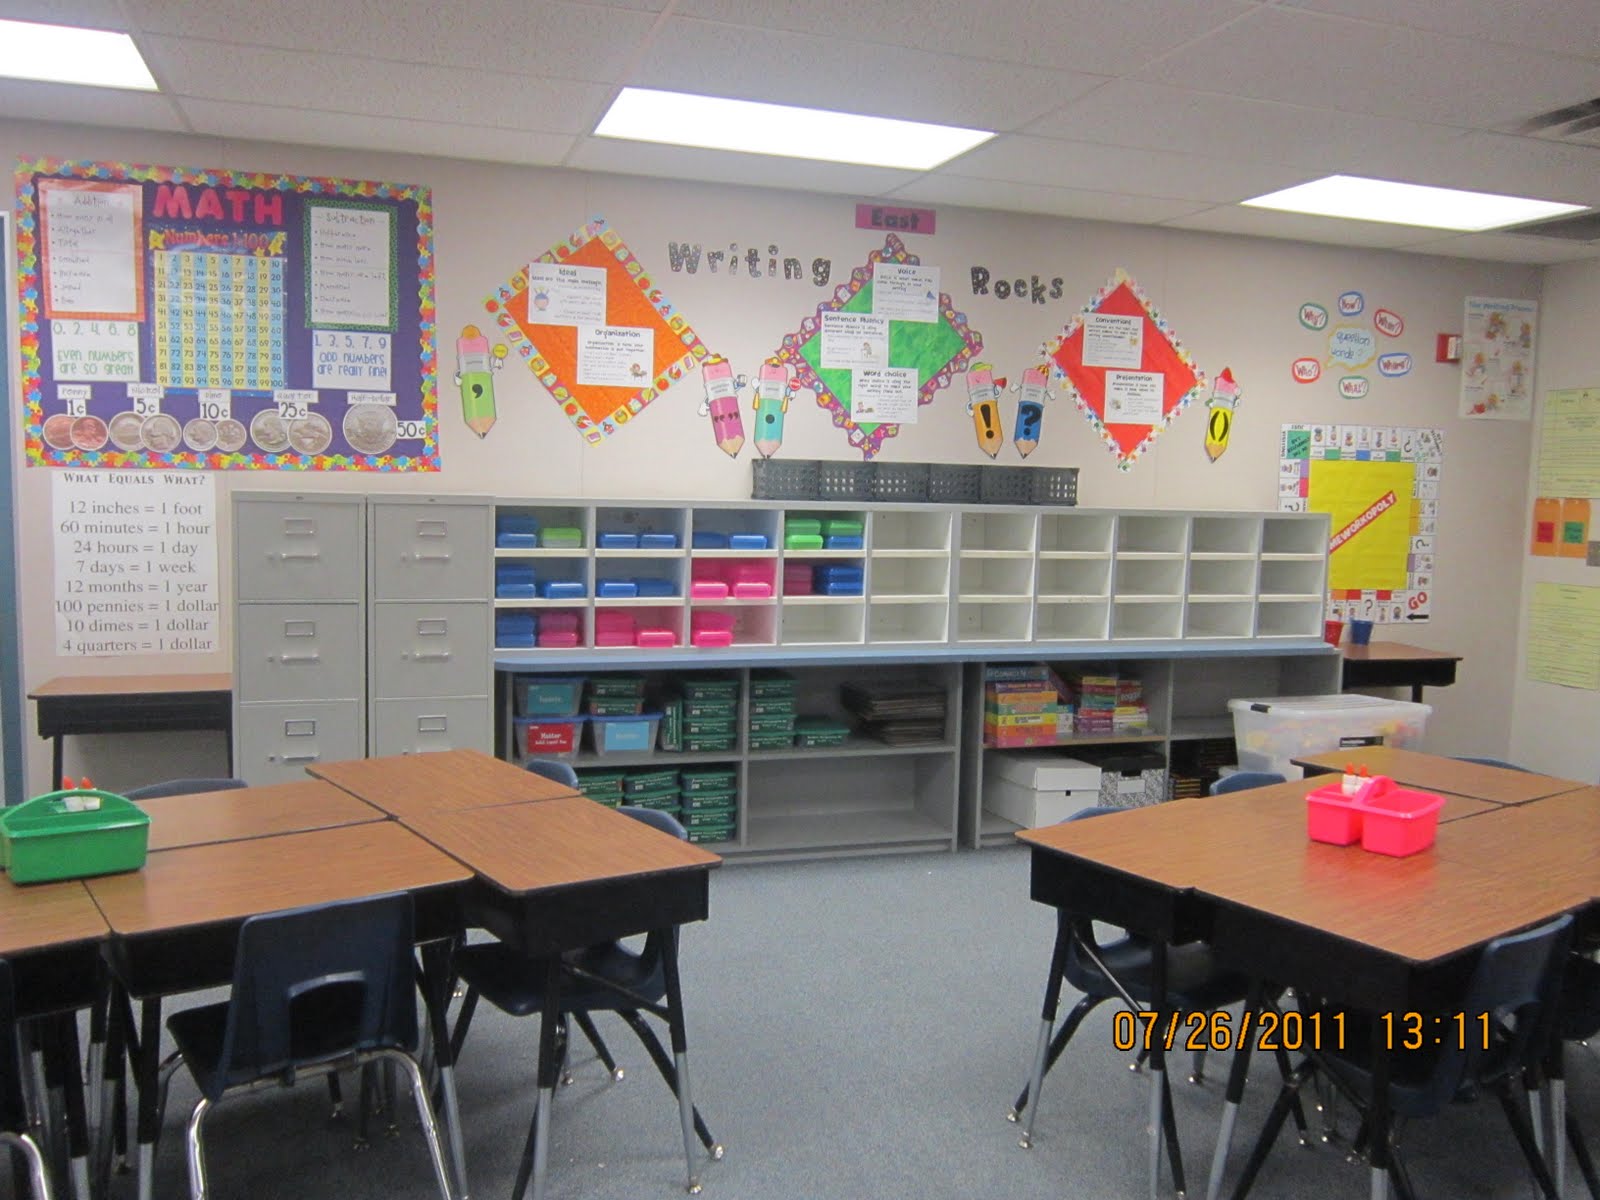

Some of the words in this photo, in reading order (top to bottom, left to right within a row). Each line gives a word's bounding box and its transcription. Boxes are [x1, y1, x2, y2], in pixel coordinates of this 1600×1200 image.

[153, 184, 283, 225] MATH
[871, 208, 920, 230] East
[668, 242, 832, 287] Writing
[970, 266, 1064, 305] Rocks
[595, 328, 641, 339] Organization
[88, 350, 134, 362] numbers
[343, 353, 385, 365] numbers
[60, 363, 77, 374] are
[84, 363, 98, 375] so
[317, 364, 333, 375] are
[64, 473, 99, 483] WHAT
[108, 473, 154, 486] EQUALS
[164, 474, 205, 486] WHAT?
[70, 501, 86, 514] 12
[92, 501, 140, 514] inches
[174, 502, 202, 515] foot
[60, 521, 80, 534] 60
[84, 521, 143, 534] minutes
[177, 522, 210, 534] hour
[74, 540, 91, 554] 24
[97, 540, 139, 554] hours
[172, 541, 199, 556] day
[77, 561, 85, 573] 7
[90, 560, 125, 576] days
[158, 561, 196, 573] week
[66, 580, 83, 593] 12
[89, 580, 143, 593] months
[177, 583, 208, 596] year
[56, 600, 82, 612] 100
[87, 600, 144, 615] pennies
[177, 599, 220, 612] dollar
[1408, 591, 1428, 610] GO
[67, 620, 84, 632] 10
[89, 619, 134, 632] dimes
[167, 619, 209, 631] dollar
[63, 639, 72, 651] 4
[77, 639, 137, 654] quarters
[170, 638, 212, 650] dollar
